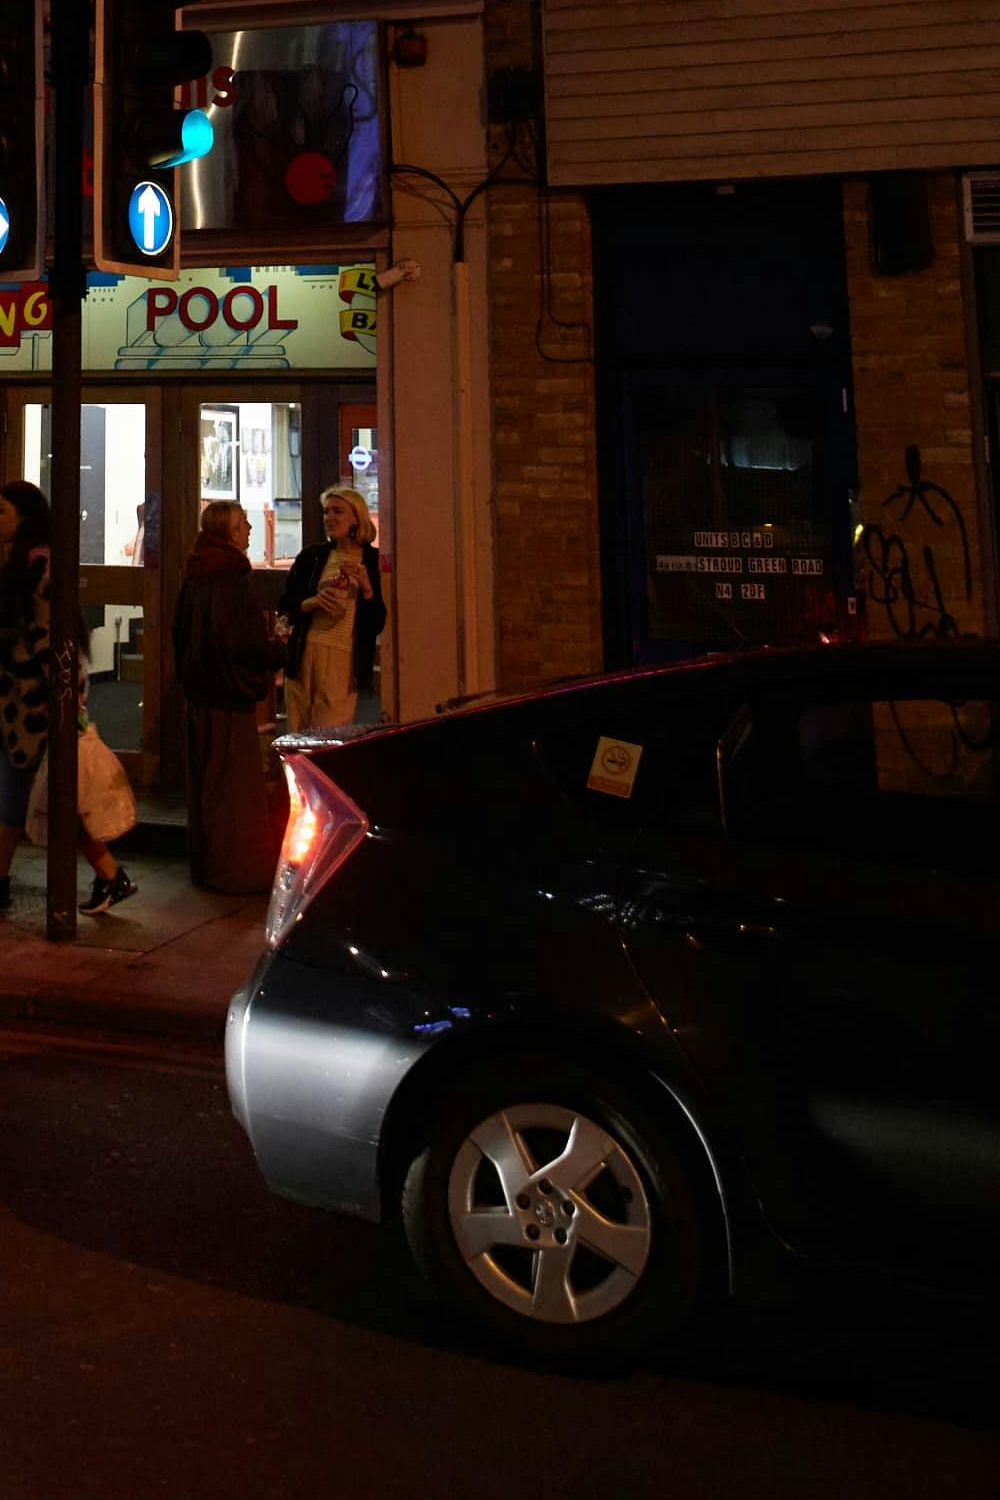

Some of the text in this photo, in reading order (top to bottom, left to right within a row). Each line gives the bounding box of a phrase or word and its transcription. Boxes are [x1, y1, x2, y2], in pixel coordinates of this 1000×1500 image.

[146, 285, 298, 332] POOL
[695, 532, 728, 548] UNITS
[699, 557, 742, 572] STROUD
[749, 557, 786, 573] GREEN
[792, 558, 823, 575] ROAD
